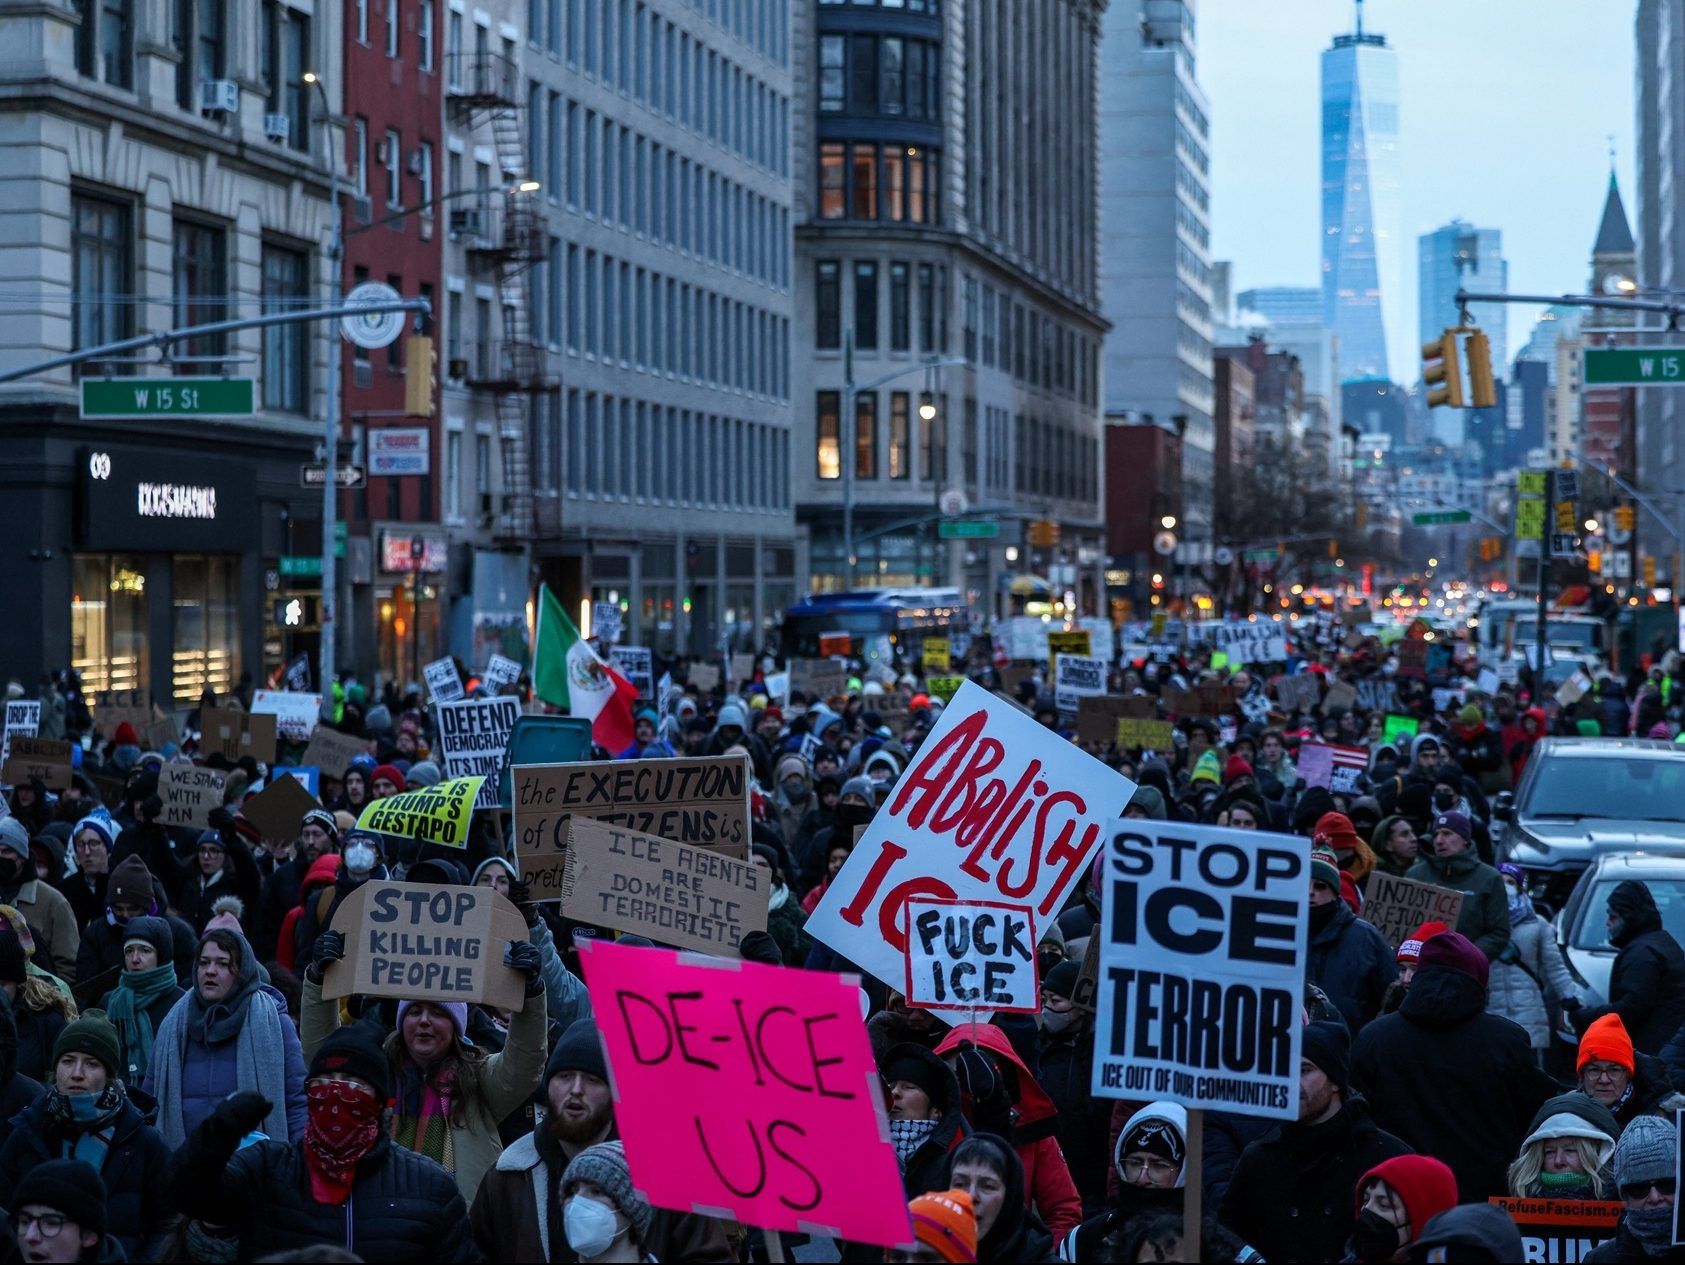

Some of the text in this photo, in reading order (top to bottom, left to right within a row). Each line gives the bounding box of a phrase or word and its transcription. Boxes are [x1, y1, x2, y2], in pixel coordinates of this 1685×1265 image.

[1639, 357, 1679, 378] W 15
[134, 388, 200, 409] W 15 St
[8, 704, 40, 725] DROP THE
[441, 702, 517, 735] DEFEND
[170, 769, 225, 791] WE STAND
[449, 757, 471, 776] IT'S
[471, 755, 500, 775] TIME
[520, 777, 556, 806] the
[561, 764, 744, 804] EXECUTION
[167, 806, 193, 823] MN
[168, 788, 201, 805] WITH
[368, 810, 458, 844] GESTAPO
[523, 817, 547, 849] of
[720, 813, 742, 843] is
[608, 830, 758, 892] ICE AGENTS
[1112, 831, 1300, 892] STOP
[610, 873, 741, 923] DOMESTIC
[661, 869, 705, 894] ARE
[1375, 878, 1458, 917] INJUSTICE
[369, 887, 476, 926] STOP
[598, 892, 742, 949] TERRORISTS
[1110, 880, 1299, 967] ICE
[369, 929, 481, 960] KILLING
[915, 908, 1033, 962] FUCK
[371, 957, 475, 992] PEOPLE
[932, 960, 1015, 1005] ICE
[1106, 967, 1294, 1078] TERROR
[615, 989, 856, 1100] DE-ICE
[1101, 1062, 1290, 1110] ICE OUT OF OUR COMMUNITIES
[693, 1115, 822, 1212] US
